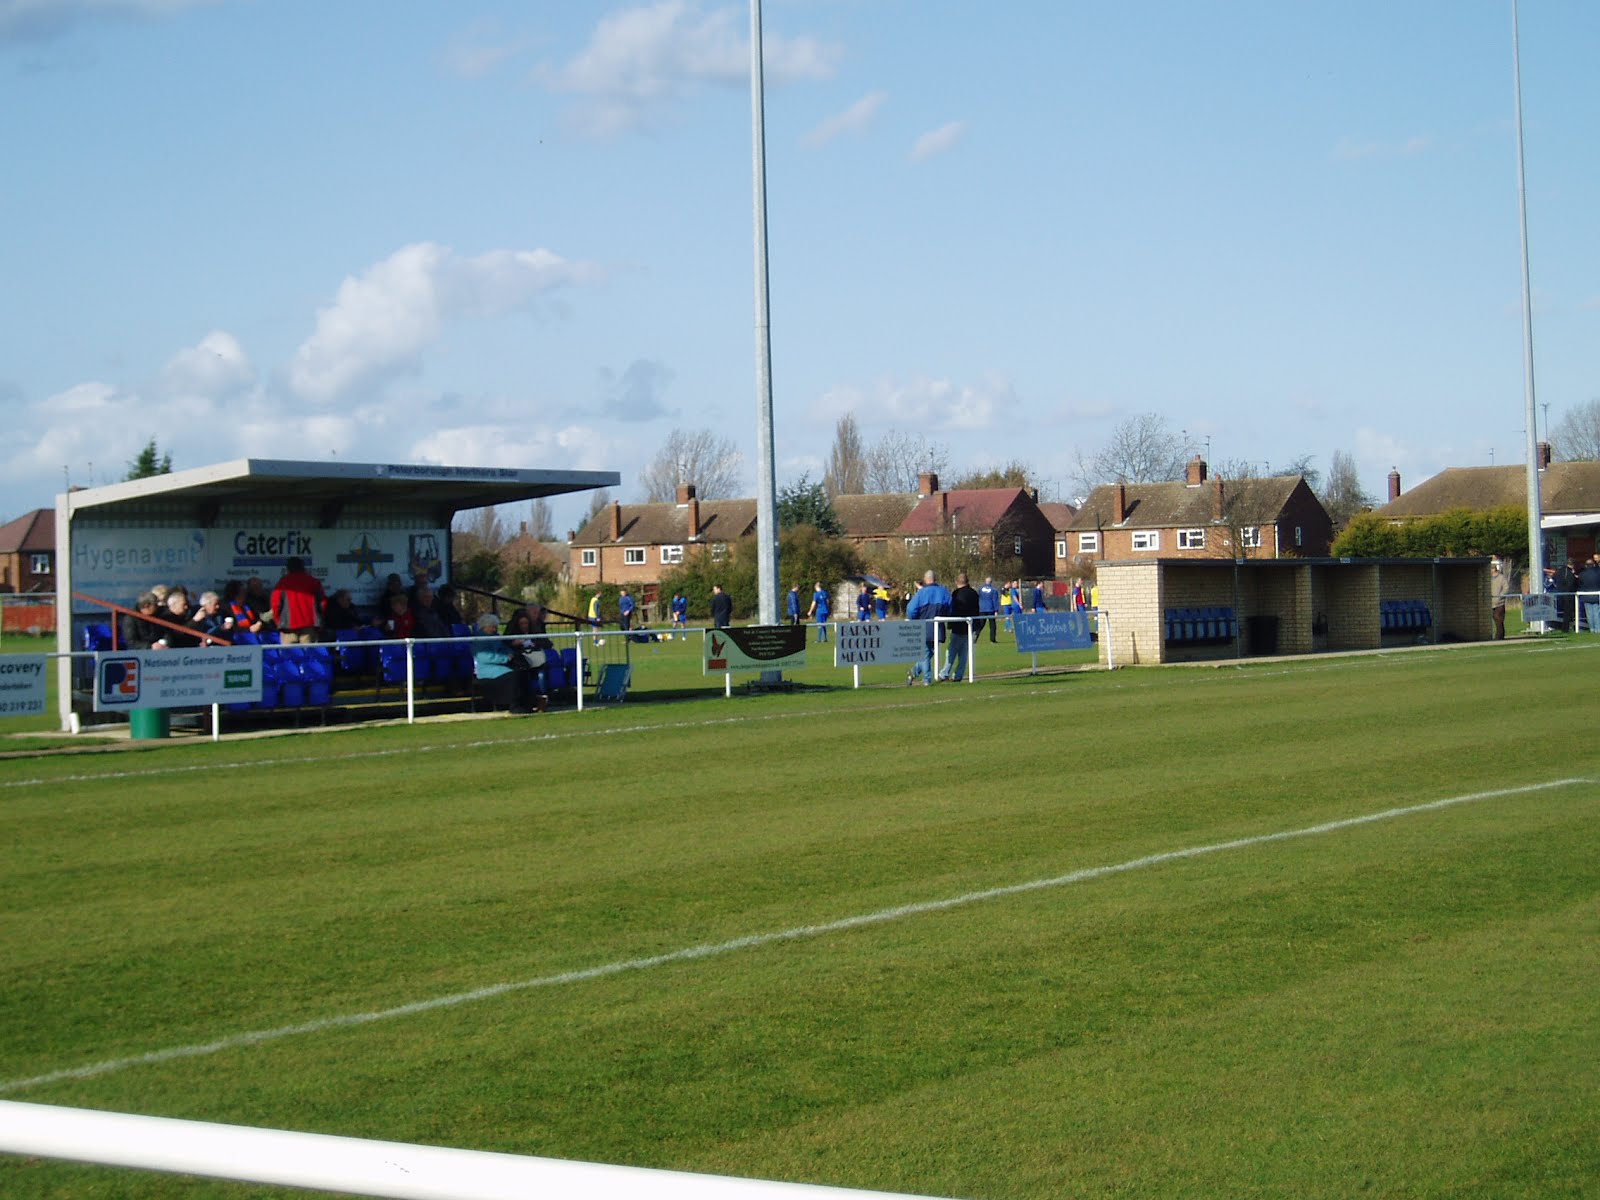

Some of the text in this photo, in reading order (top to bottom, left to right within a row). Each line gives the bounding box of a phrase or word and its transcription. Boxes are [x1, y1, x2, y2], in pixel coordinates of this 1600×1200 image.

[233, 530, 312, 556] CaterFix
[74, 543, 198, 571] Hygenavent
[1018, 616, 1036, 636] The
[144, 653, 253, 668] National Generator Rental
[841, 651, 876, 663] MEATS
[0, 663, 43, 677] covery
